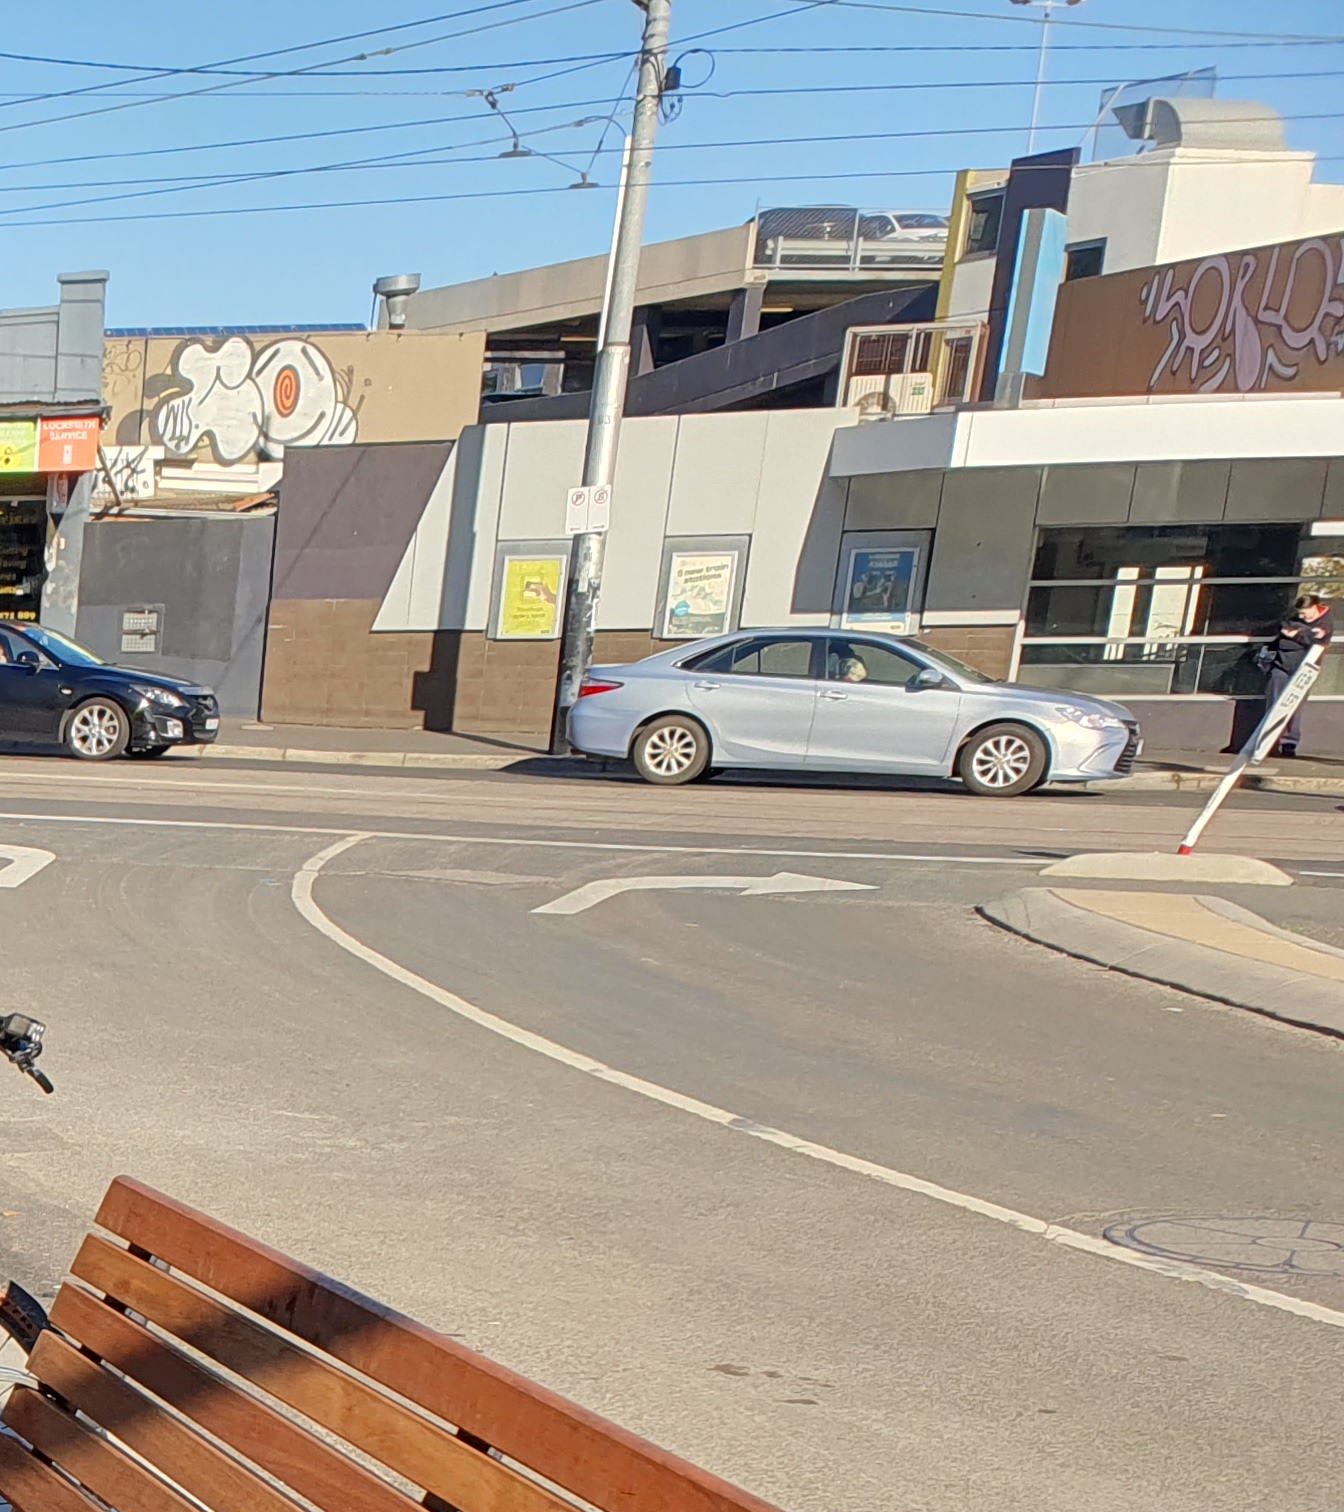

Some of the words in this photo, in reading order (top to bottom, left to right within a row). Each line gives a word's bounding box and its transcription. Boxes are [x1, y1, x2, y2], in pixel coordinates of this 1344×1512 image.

[43, 420, 96, 431] LOCKSMITH
[49, 431, 88, 440] SERVICE
[705, 562, 729, 573] train
